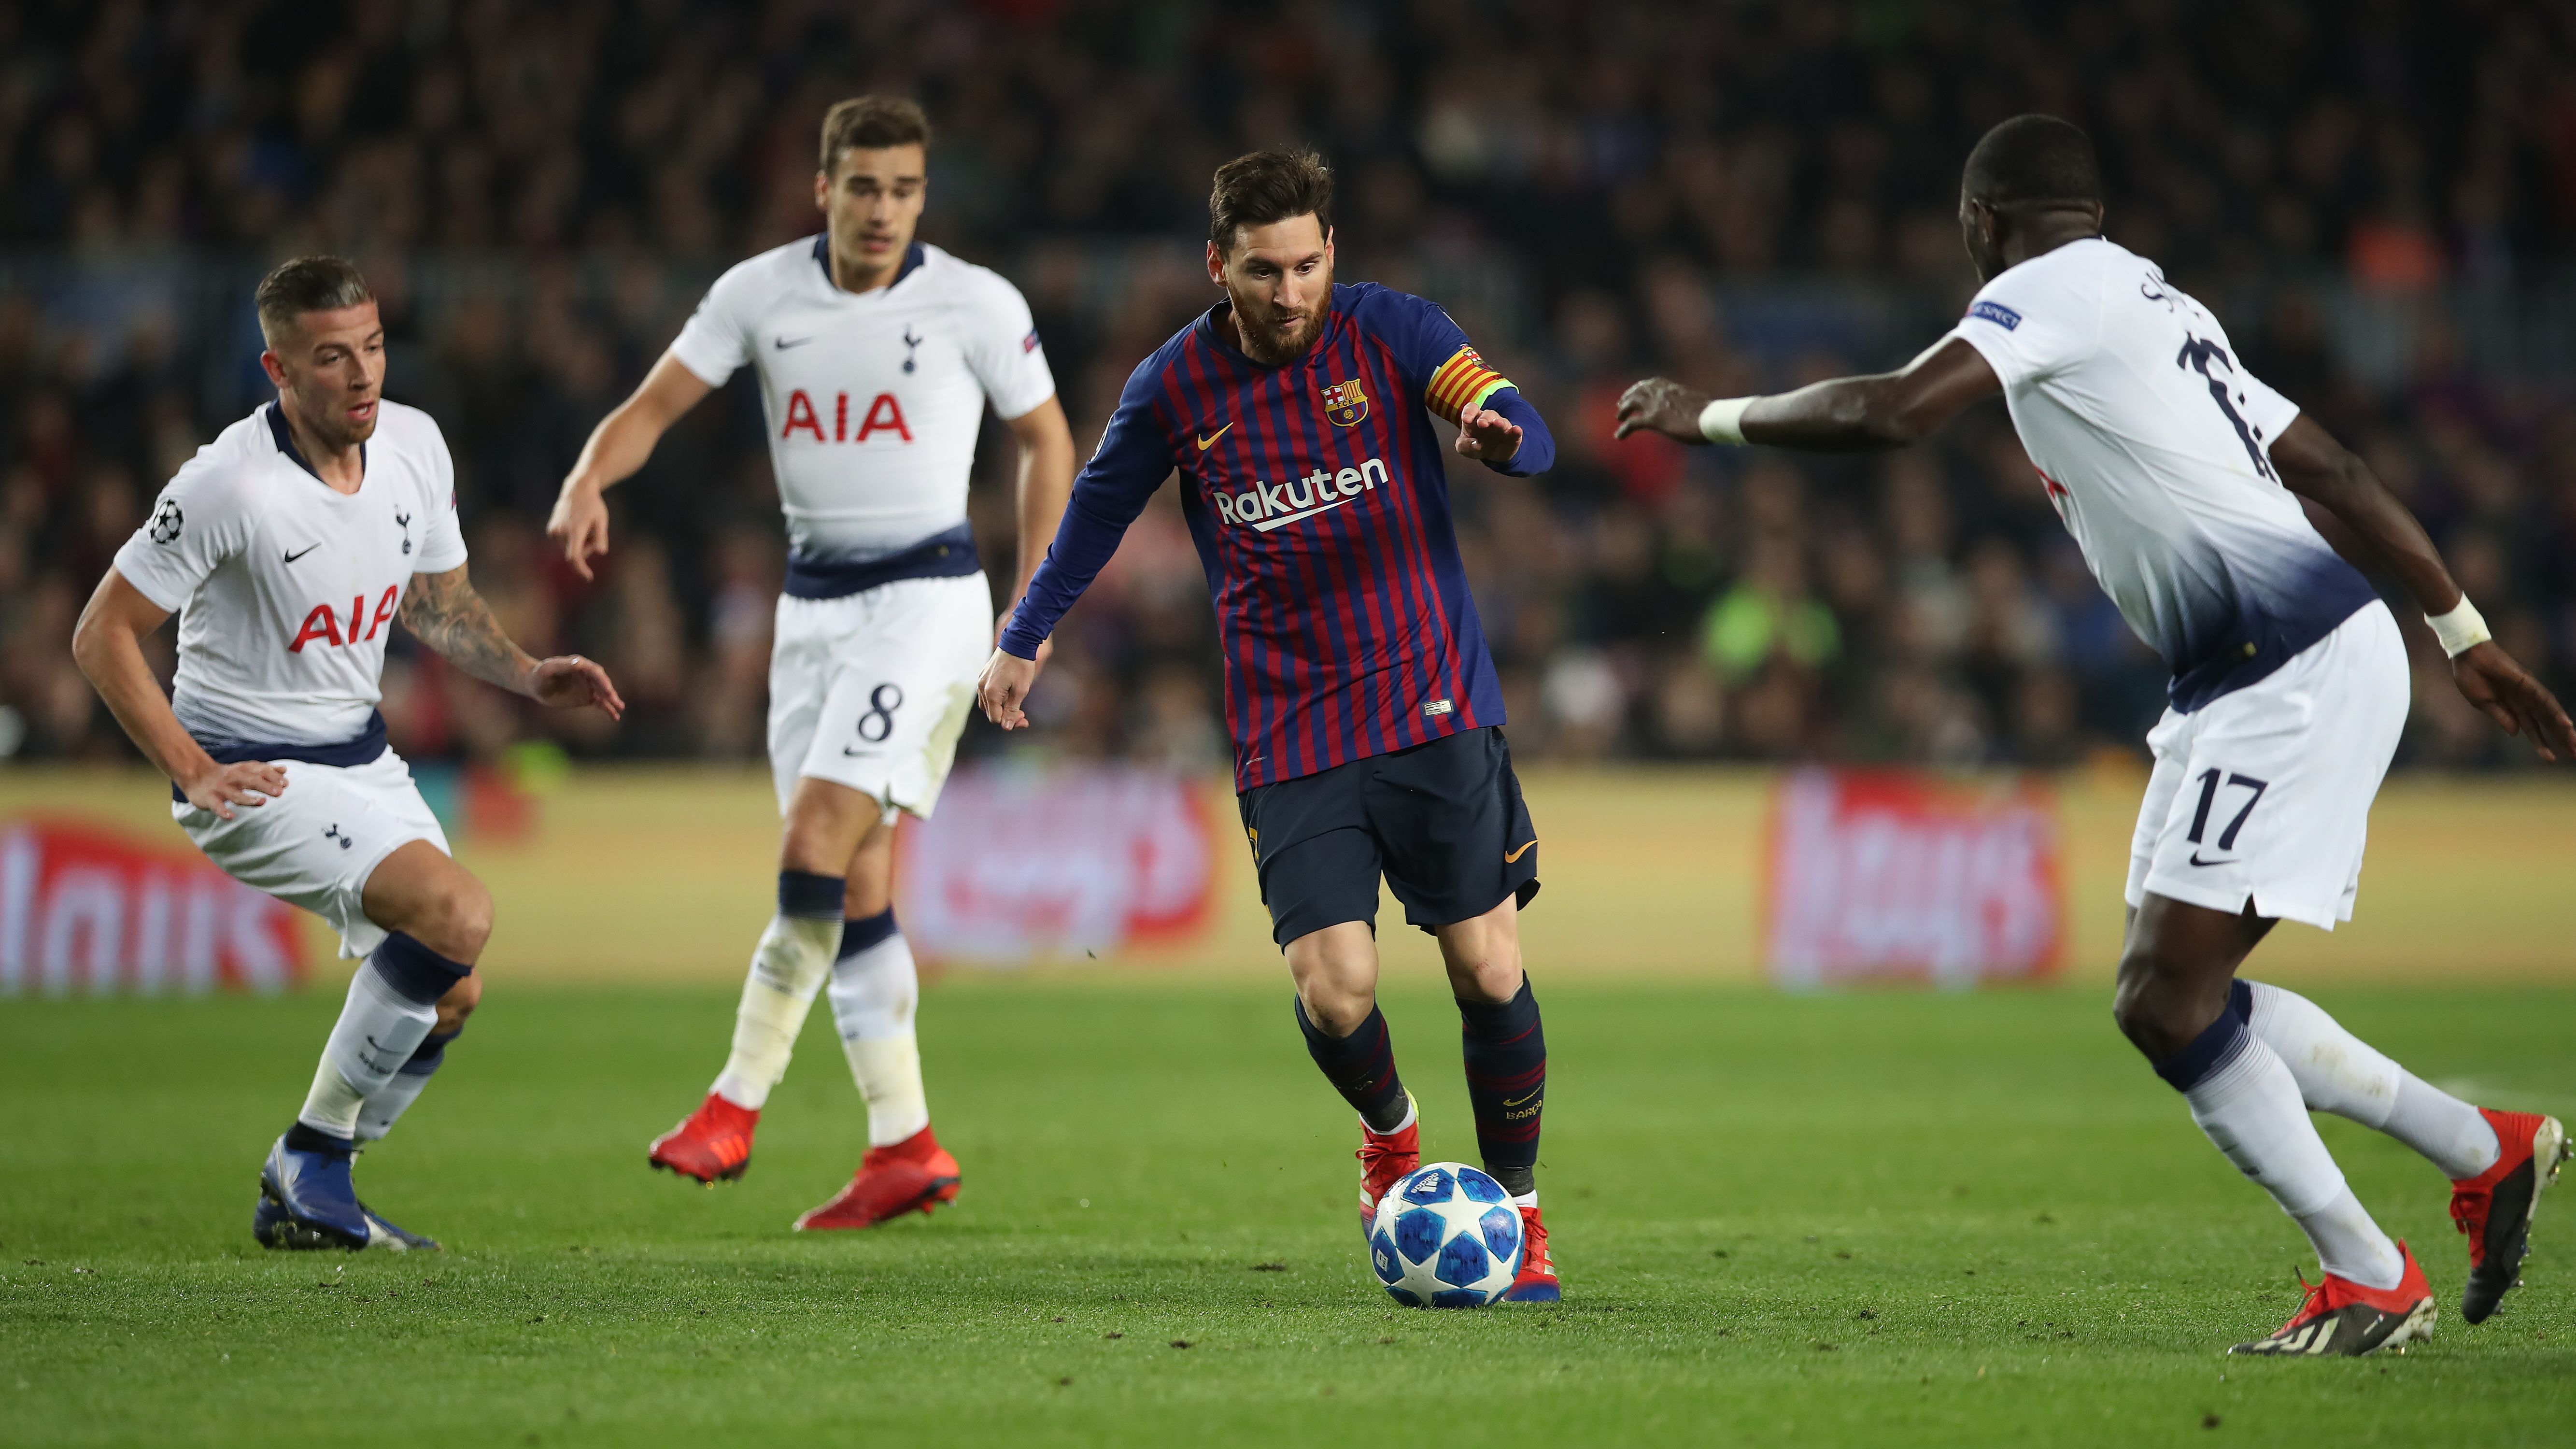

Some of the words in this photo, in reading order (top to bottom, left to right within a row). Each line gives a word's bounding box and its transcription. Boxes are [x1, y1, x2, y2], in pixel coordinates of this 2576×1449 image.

[782, 389, 913, 443] AIA
[1337, 399, 1354, 408] FCB
[1213, 458, 1388, 524] Rakuten
[289, 583, 397, 653] AIA
[858, 682, 903, 743] 8
[2187, 766, 2268, 851] 17
